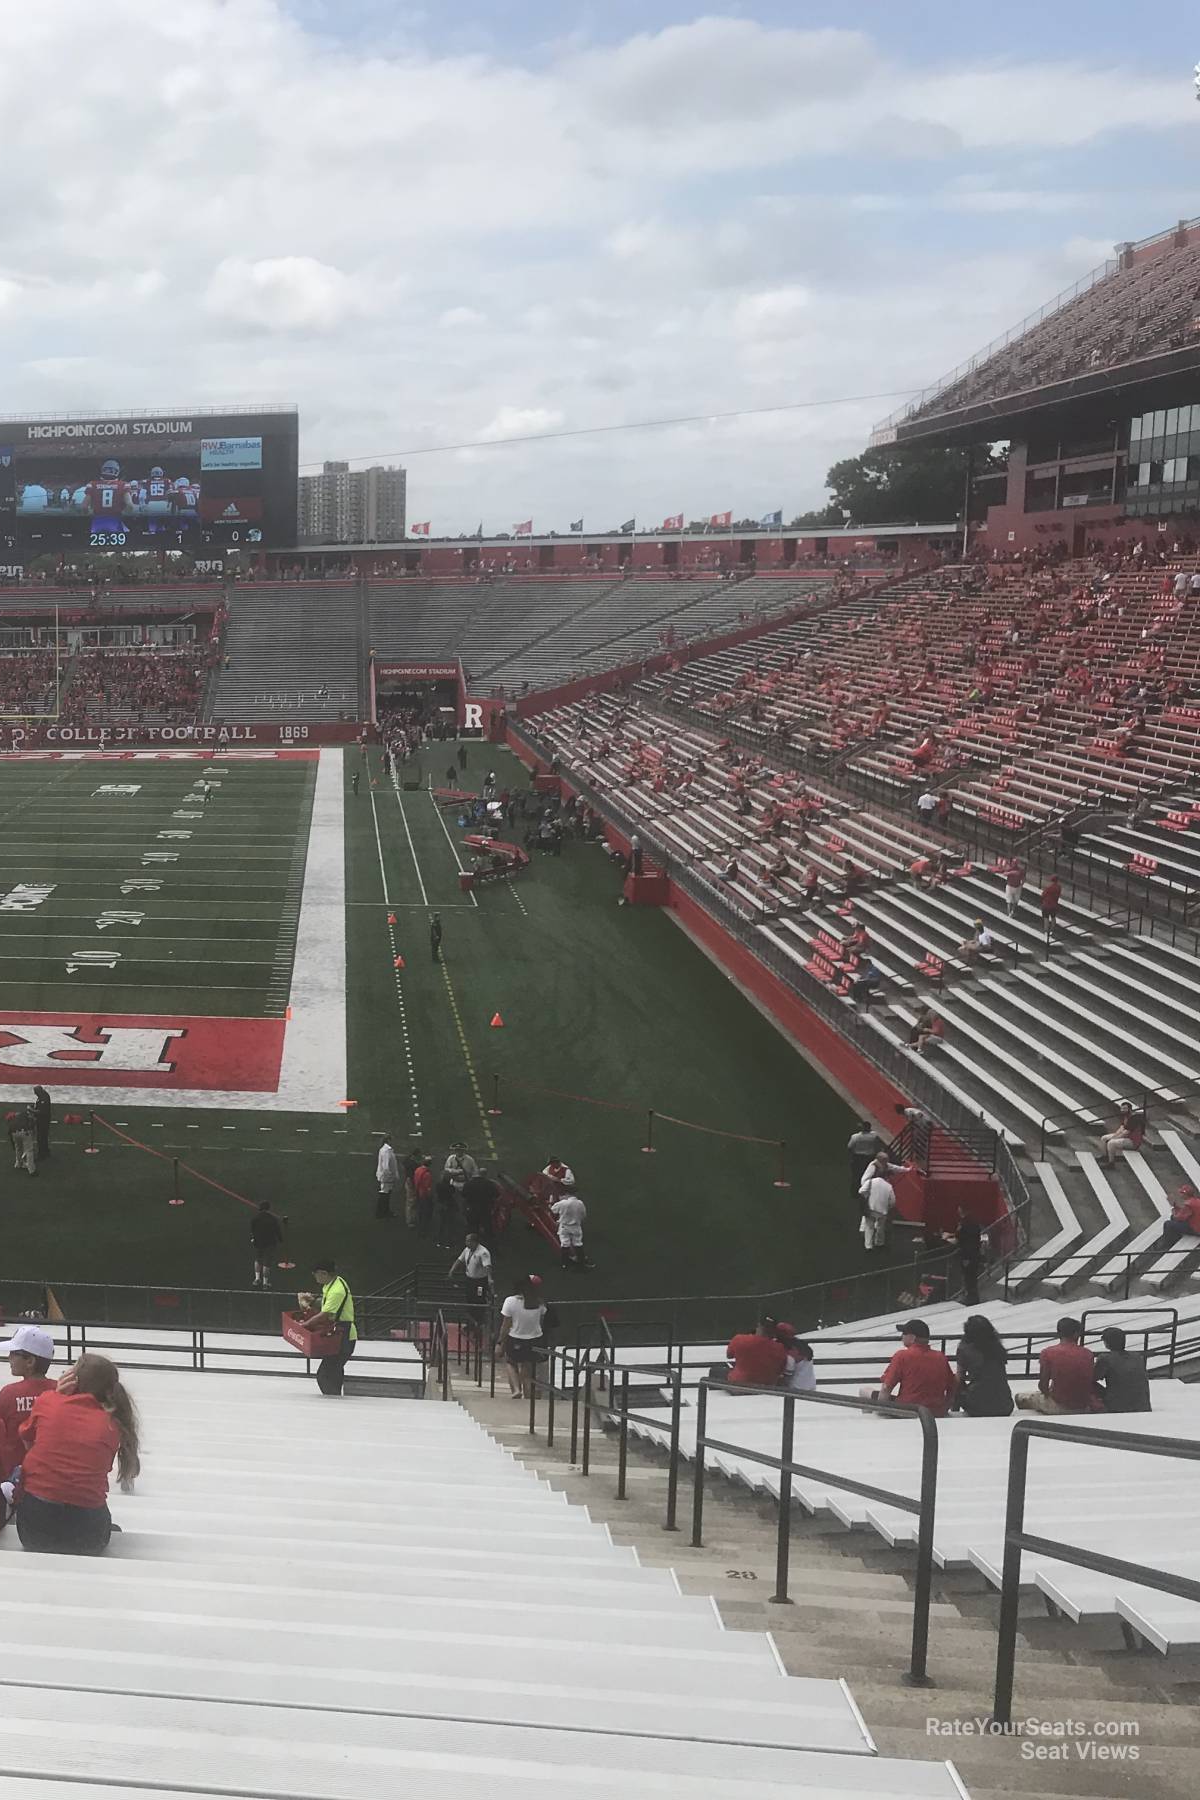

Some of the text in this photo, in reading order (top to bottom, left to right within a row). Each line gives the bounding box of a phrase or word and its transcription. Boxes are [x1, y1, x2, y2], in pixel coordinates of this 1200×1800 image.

[28, 421, 193, 439] HIGHPOINT.COM STADIUM
[90, 533, 126, 546] 25:39
[464, 703, 484, 729] R
[279, 726, 309, 738] 1869
[95, 910, 146, 926] 20
[65, 950, 122, 969] 10
[15, 1396, 37, 1412] ME
